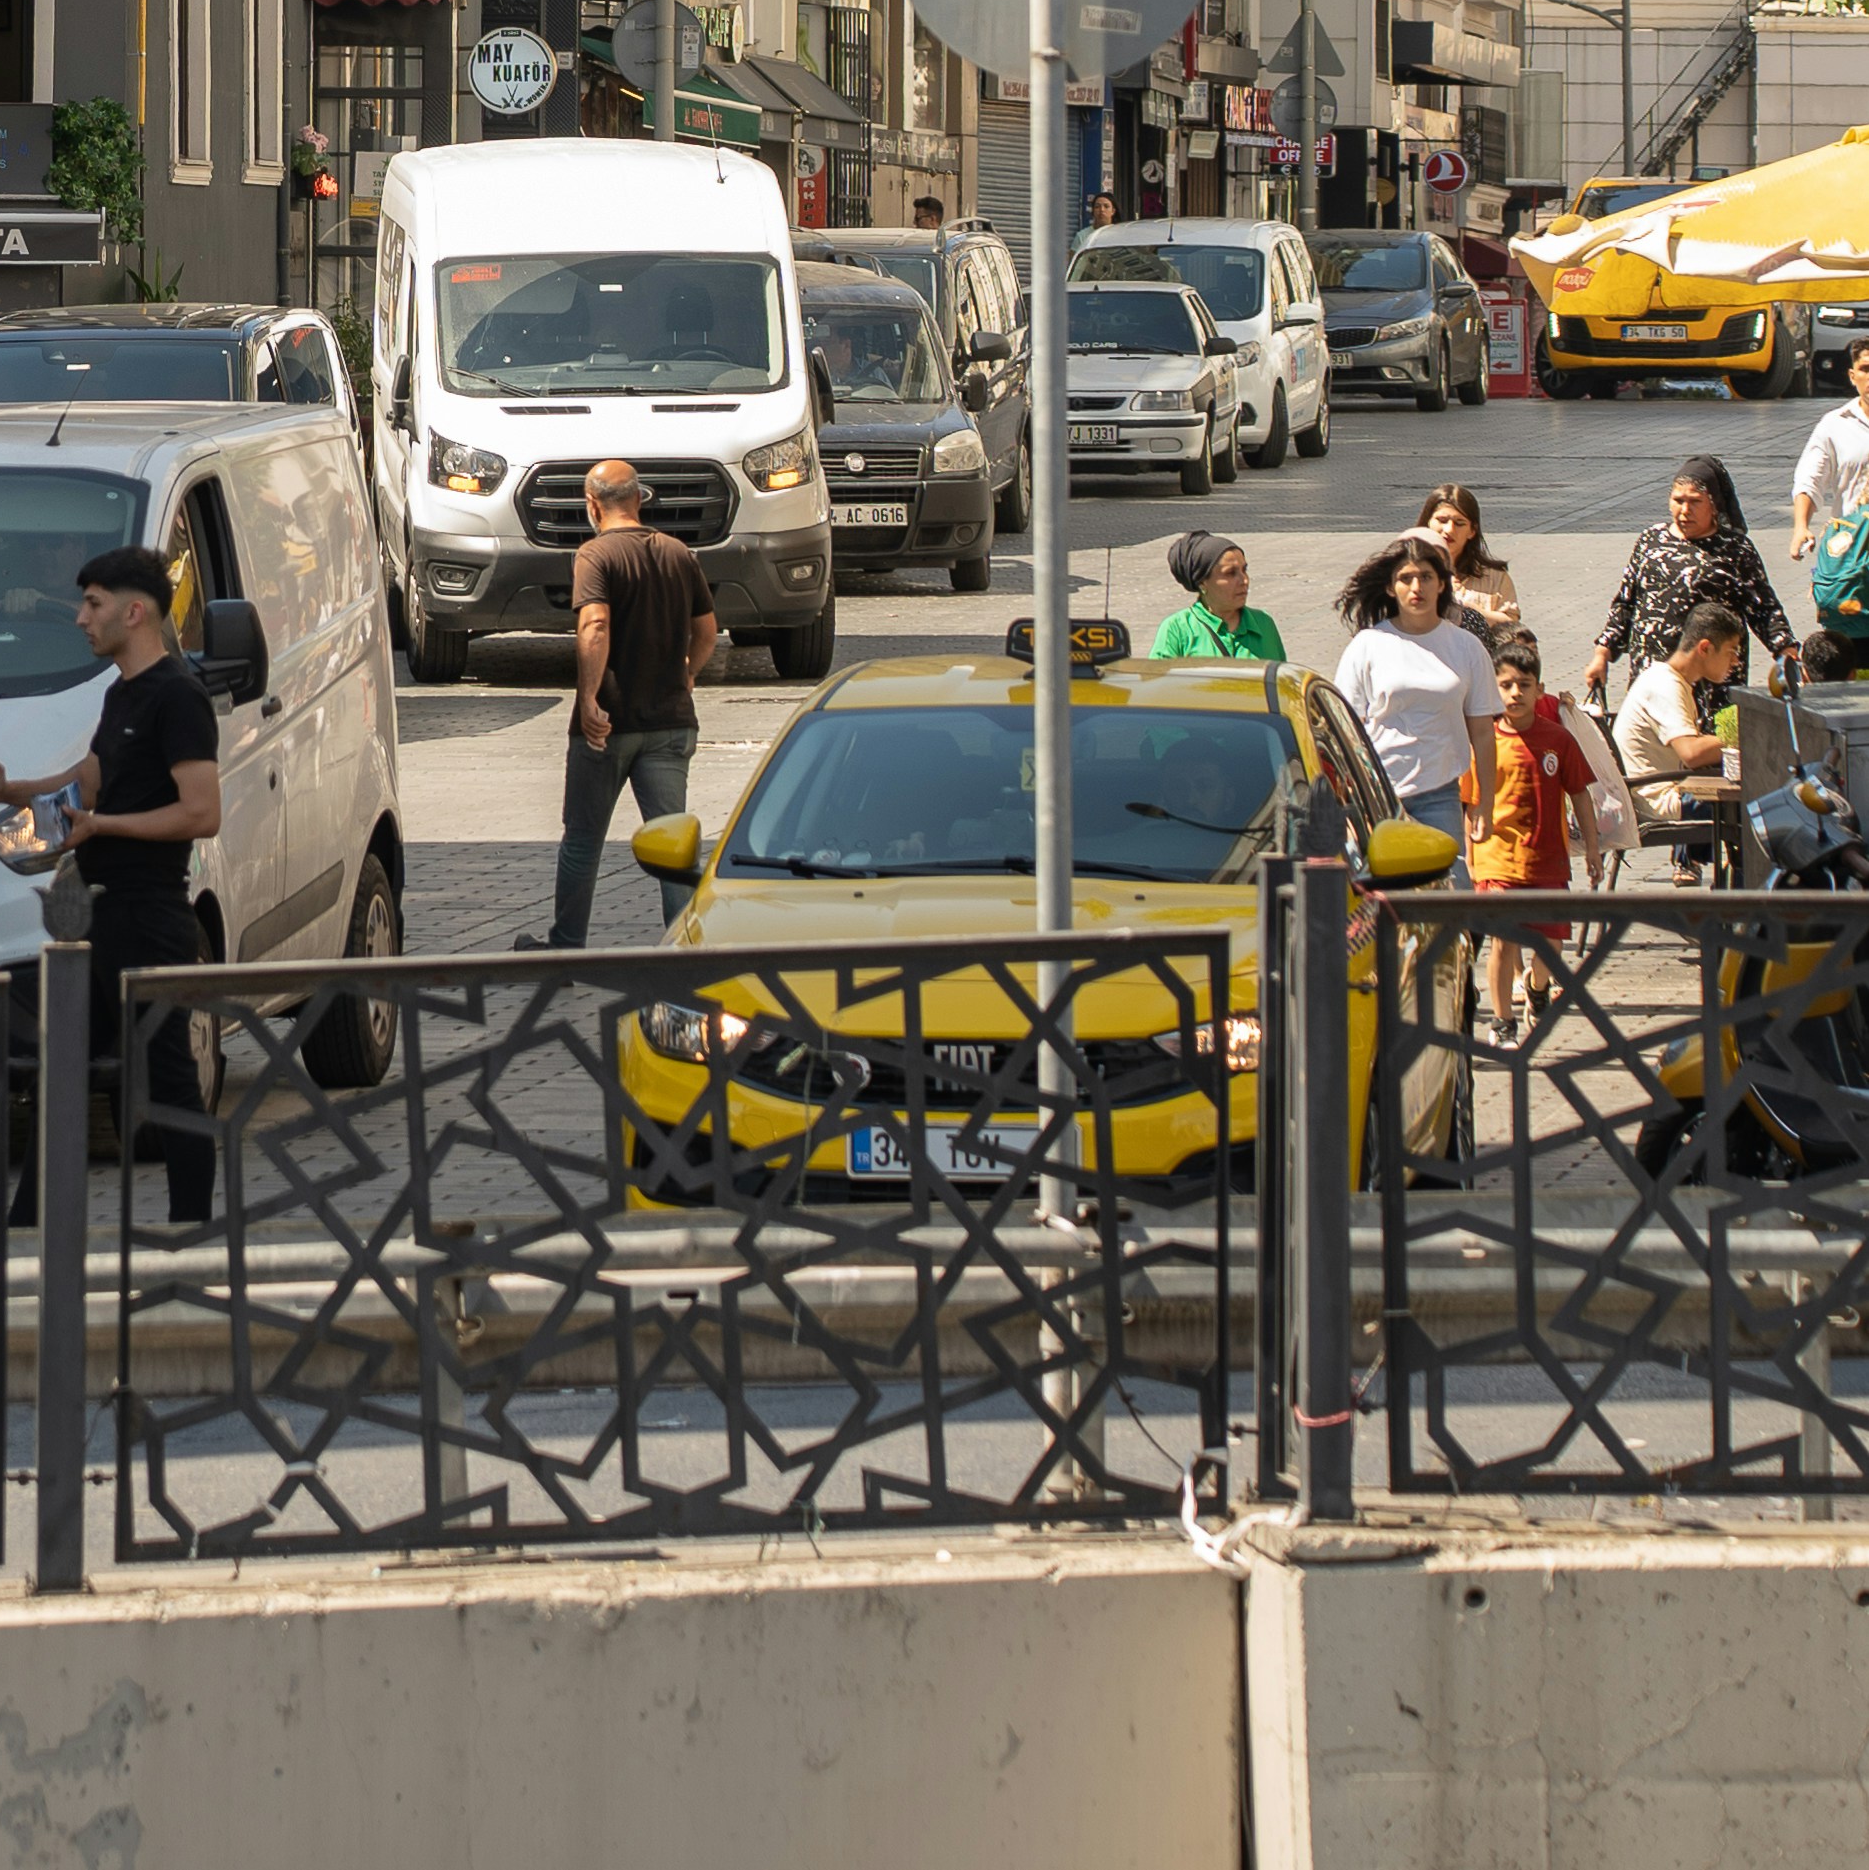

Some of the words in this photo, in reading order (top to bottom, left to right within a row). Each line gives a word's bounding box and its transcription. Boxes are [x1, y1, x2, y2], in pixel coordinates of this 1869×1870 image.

[477, 43, 514, 64] MAY
[492, 60, 551, 83] KUAFÖR
[1493, 311, 1509, 330] E
[1087, 427, 1114, 440] 1331
[846, 508, 863, 523] AC
[872, 508, 904, 523] 0616
[1021, 627, 1115, 648] TKSi
[933, 1044, 996, 1091] FIAT
[873, 1131, 910, 1168] 34
